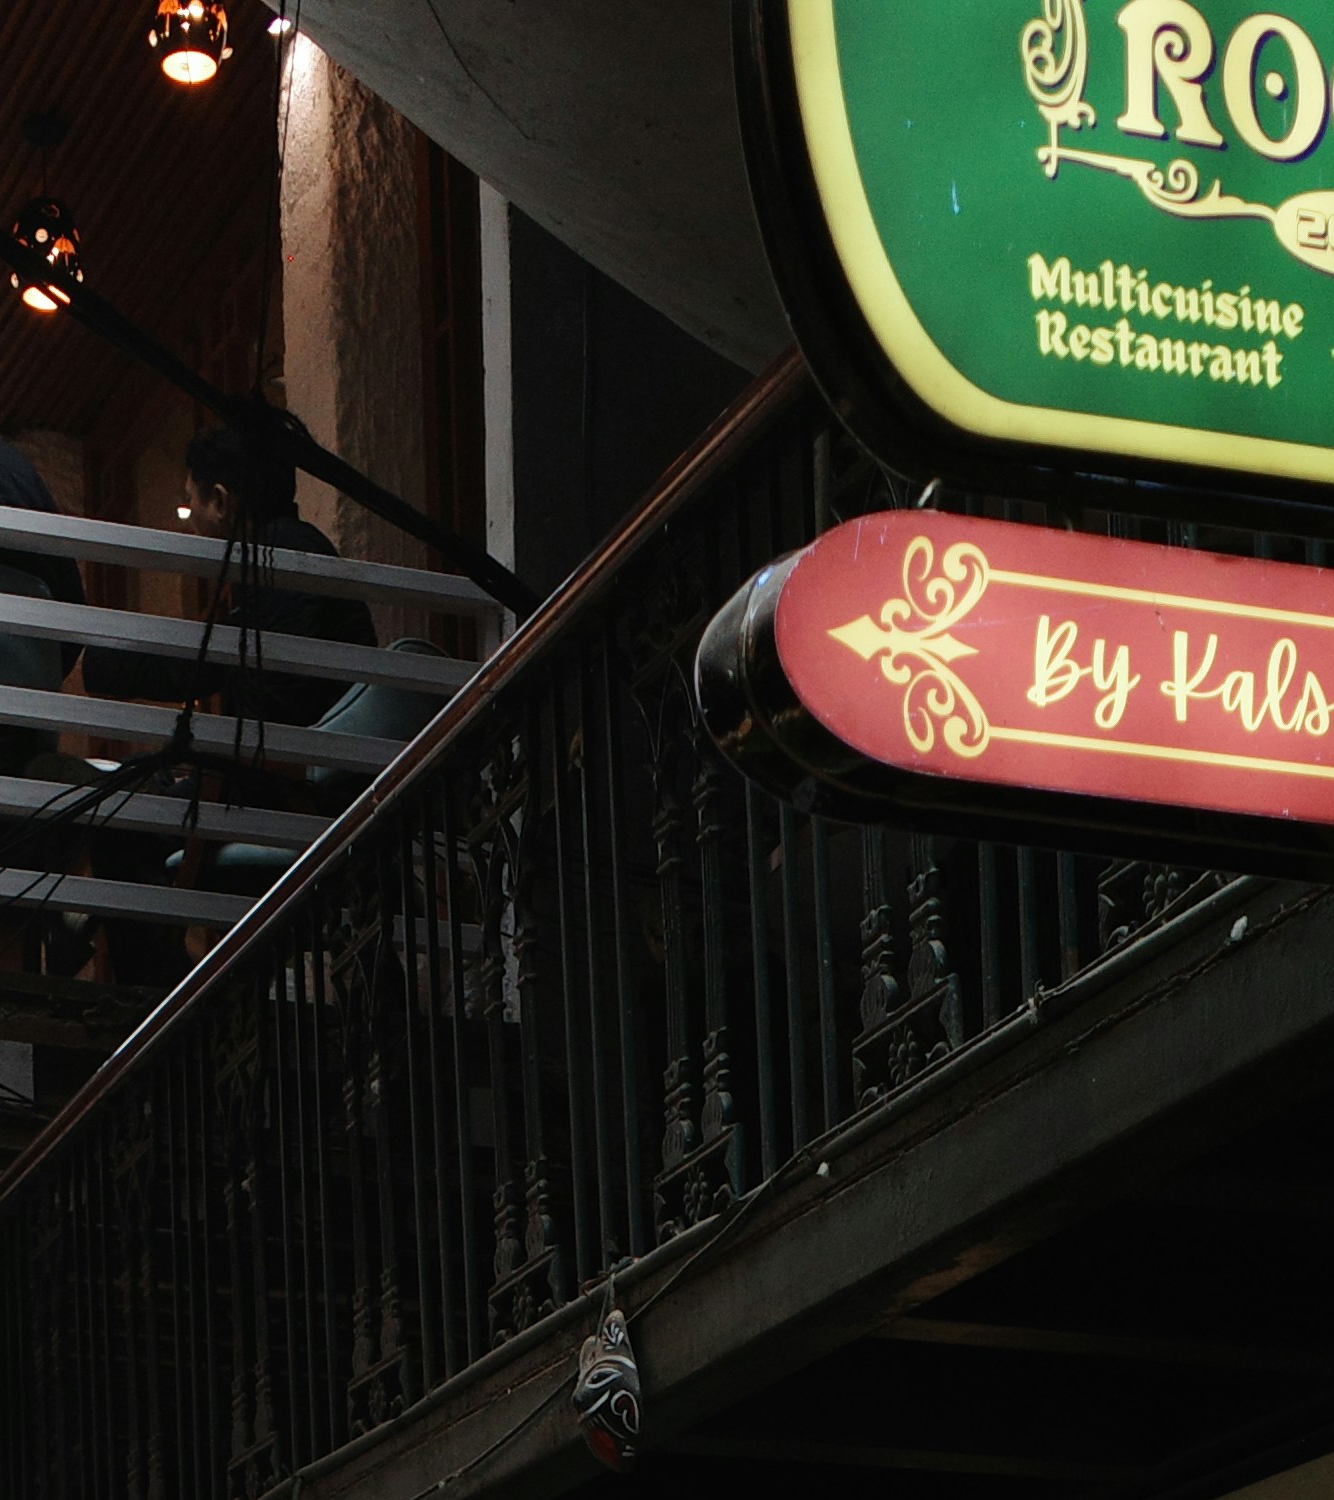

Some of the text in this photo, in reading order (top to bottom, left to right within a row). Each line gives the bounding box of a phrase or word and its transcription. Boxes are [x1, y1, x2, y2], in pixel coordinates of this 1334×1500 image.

[1028, 252, 1304, 340] Multicuisine
[1035, 309, 1283, 389] Restaurant
[1026, 614, 1141, 729] By
